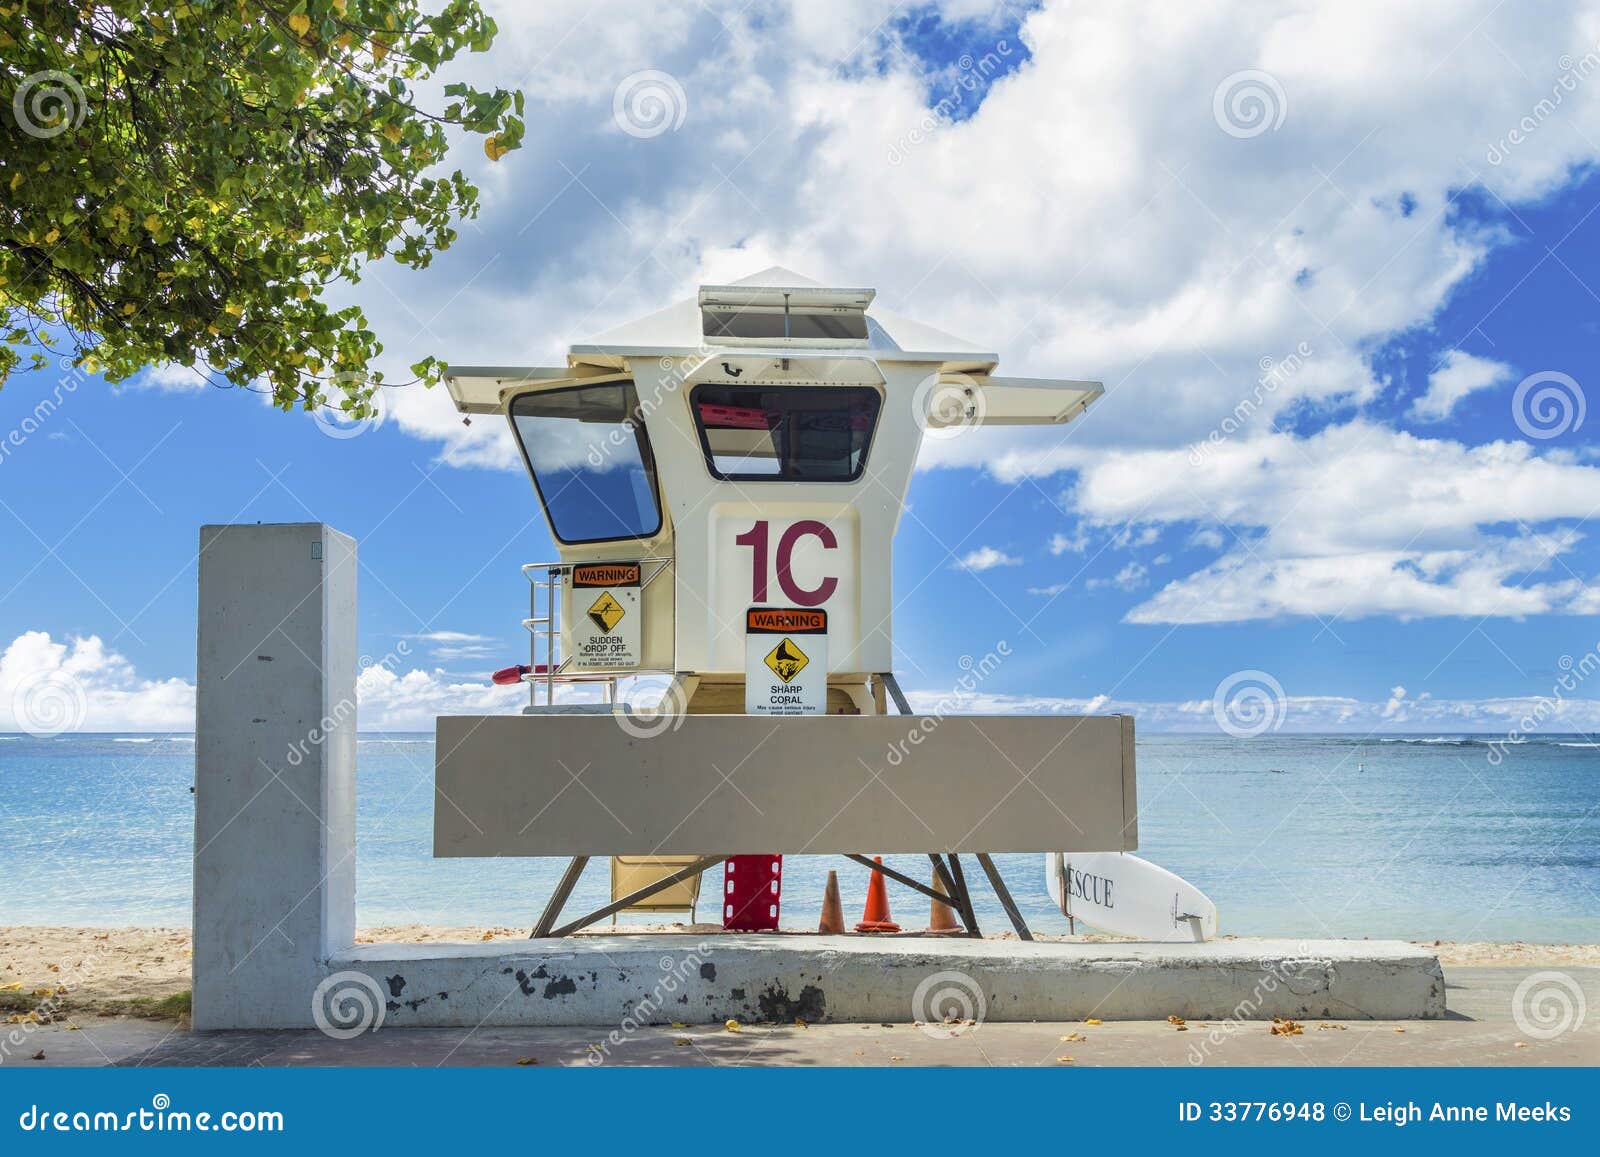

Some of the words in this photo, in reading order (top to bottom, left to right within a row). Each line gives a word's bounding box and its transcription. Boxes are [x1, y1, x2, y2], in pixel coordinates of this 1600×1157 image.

[736, 520, 839, 607] 1C
[579, 569, 635, 582] WARNING
[754, 615, 820, 627] WARNING
[590, 636, 623, 644] SUDDEN
[585, 644, 608, 653] DROP
[610, 644, 626, 653] OFF
[770, 685, 803, 694] SHARP
[770, 695, 803, 704] CORAL
[1066, 867, 1114, 909] ESCUE
